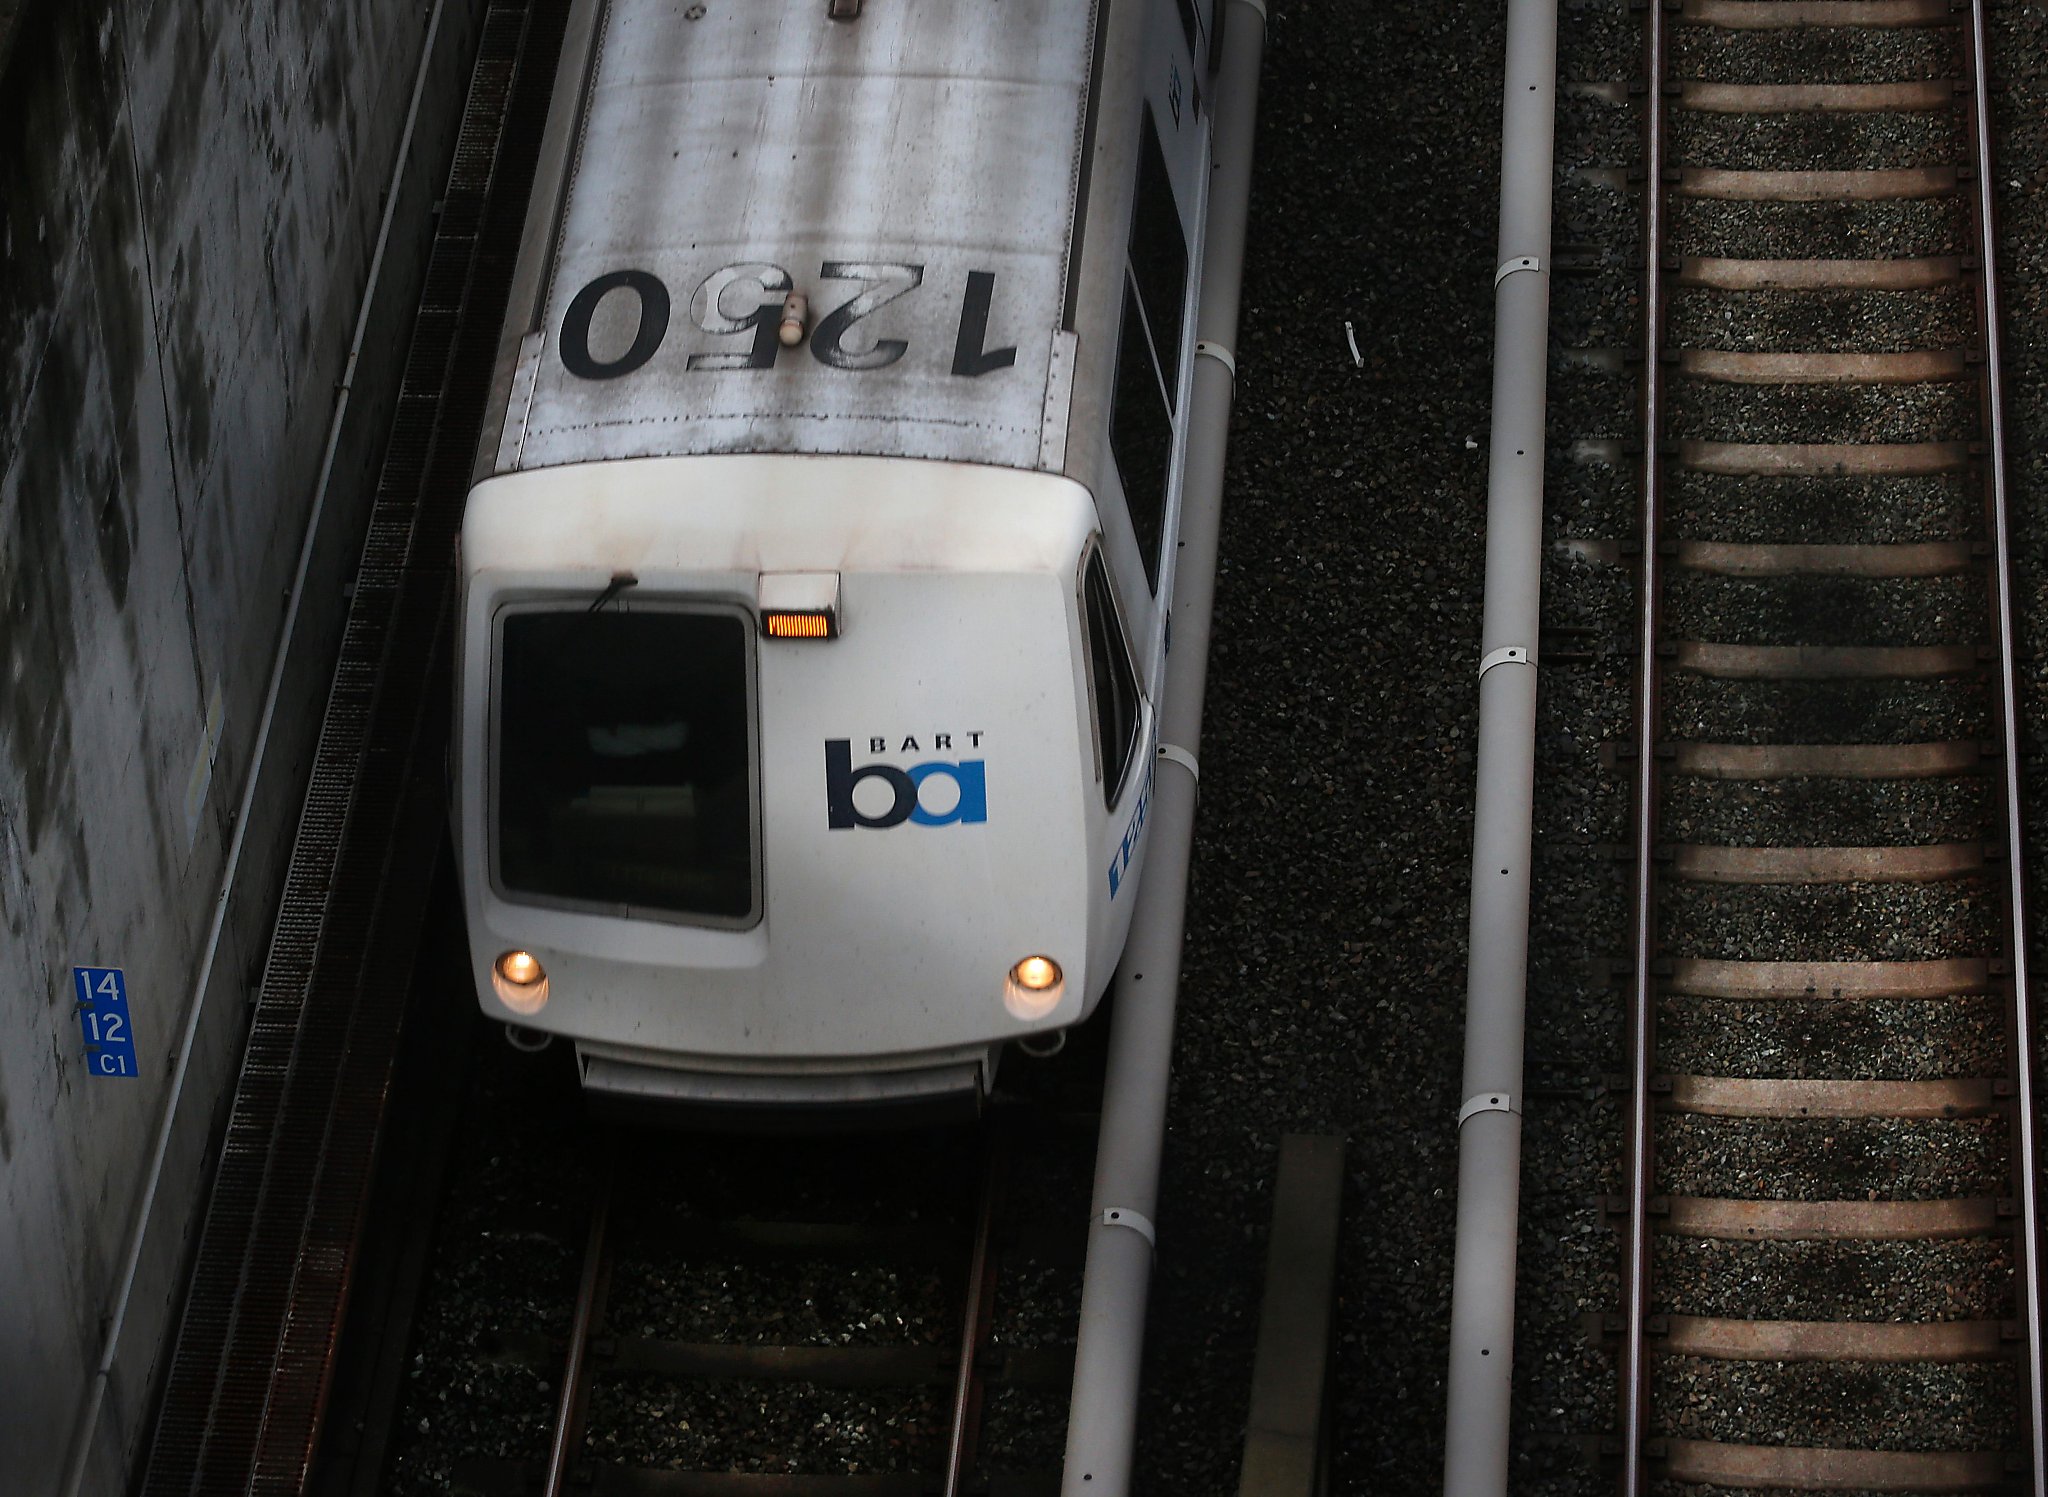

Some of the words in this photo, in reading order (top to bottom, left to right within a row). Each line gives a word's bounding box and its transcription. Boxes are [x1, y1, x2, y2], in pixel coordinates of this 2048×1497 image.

[558, 261, 1017, 380] 1250
[870, 731, 984, 753] BART
[81, 971, 119, 1000] 14
[88, 1013, 126, 1042] 12
[100, 1054, 126, 1074] C1
